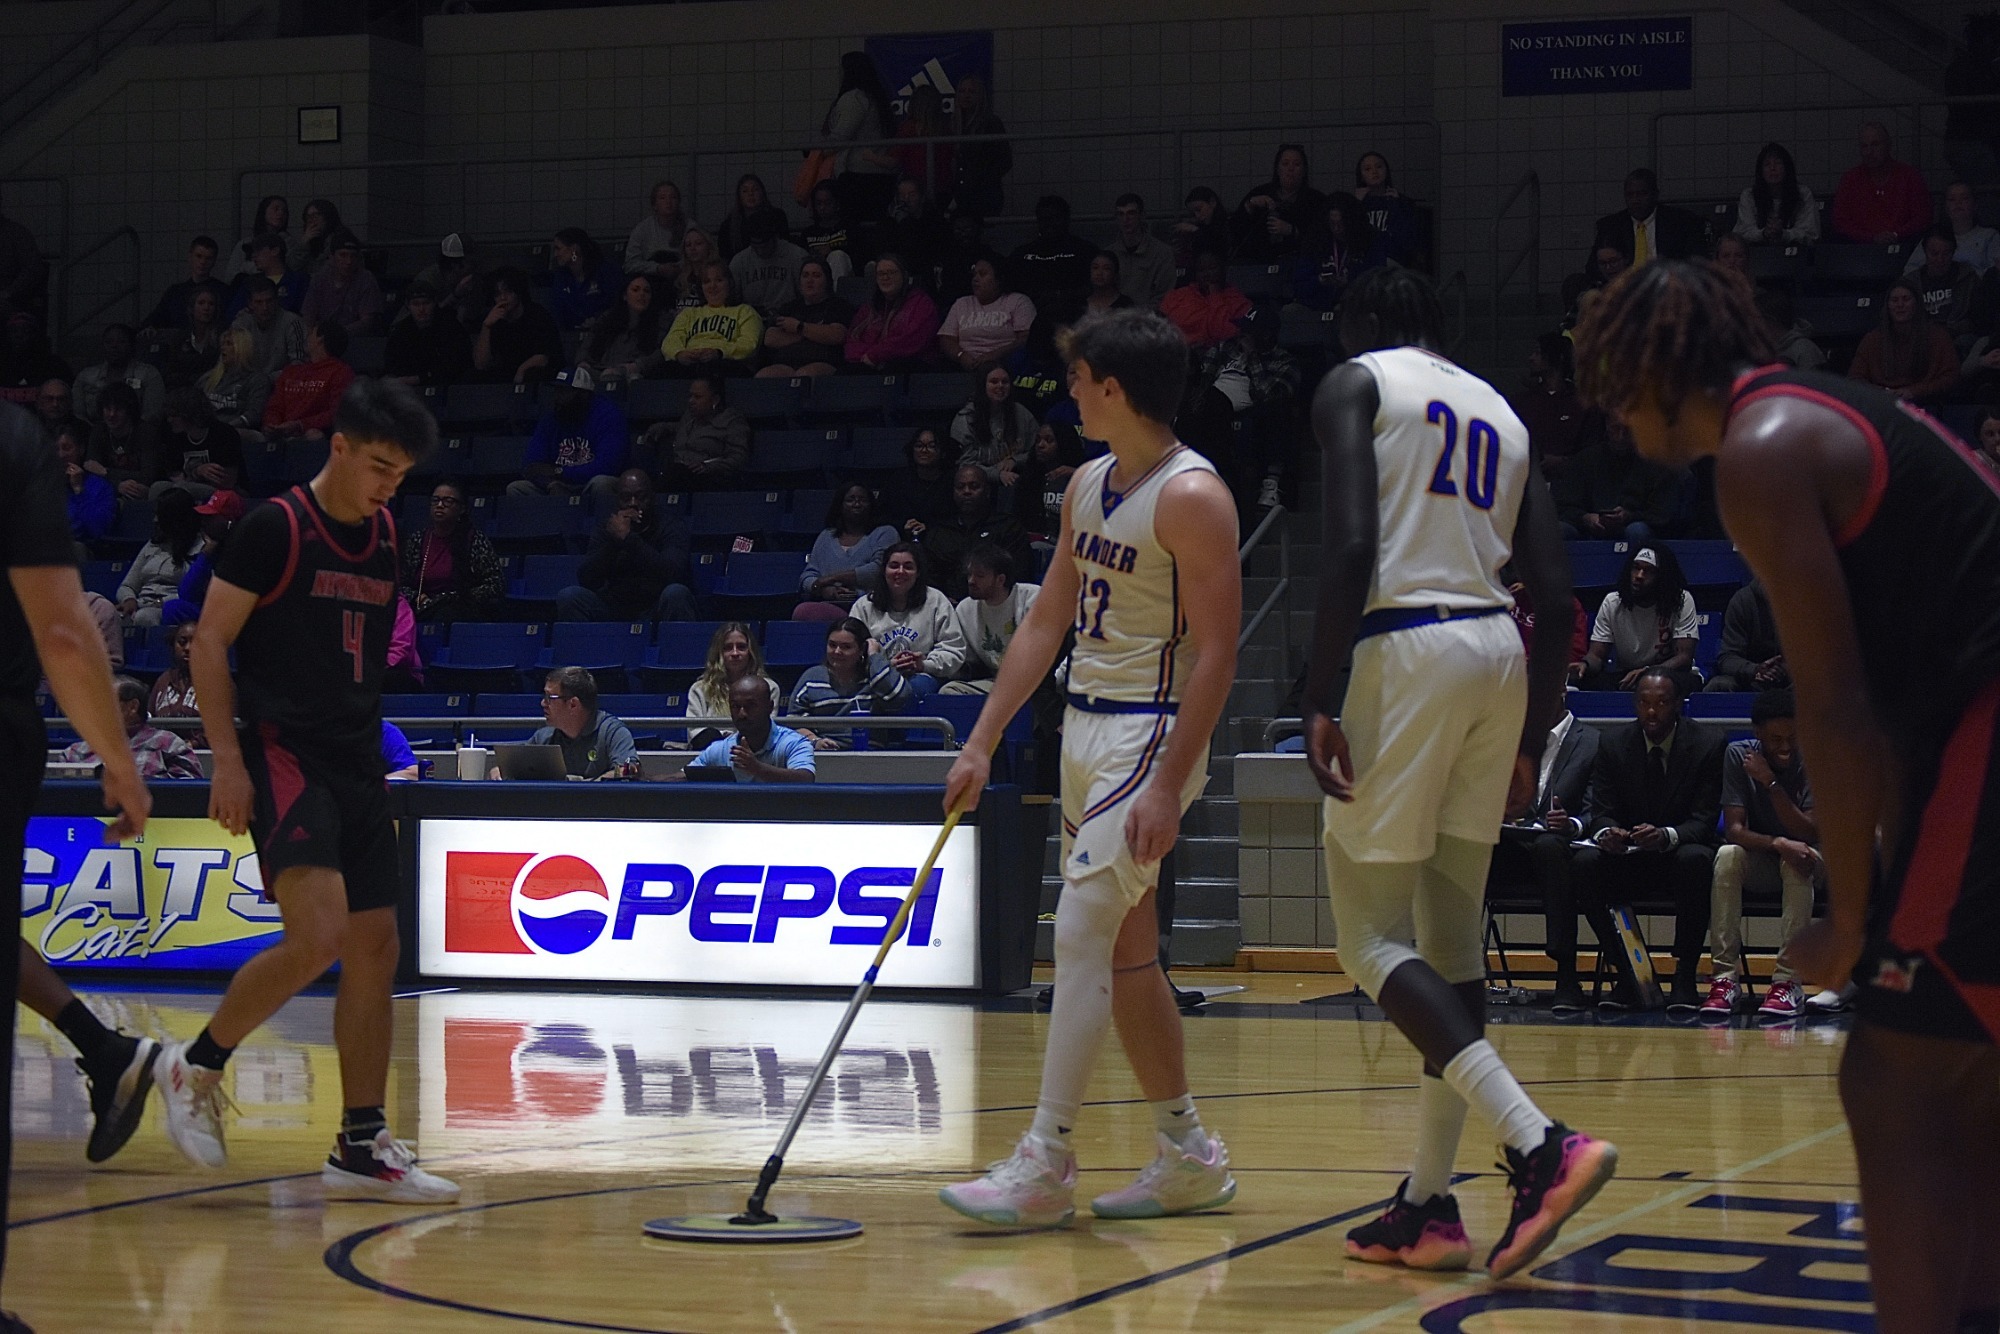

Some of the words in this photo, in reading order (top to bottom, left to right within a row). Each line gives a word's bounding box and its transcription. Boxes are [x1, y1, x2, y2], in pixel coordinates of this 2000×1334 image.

[1509, 37, 1532, 50] NO
[1535, 34, 1614, 49] STANDING
[1619, 32, 1636, 46] IN
[1640, 31, 1685, 45] AISLE
[1550, 65, 1605, 80] THANK
[1609, 64, 1643, 78] YOU
[745, 265, 787, 284] LANDER
[959, 311, 1008, 328] LANDER
[1427, 400, 1500, 510] 20
[1074, 531, 1137, 573] ANDER
[1077, 572, 1111, 641] 12
[343, 610, 366, 683] 4
[878, 627, 919, 647] LANDER
[612, 863, 943, 946] PEPSI
[39, 902, 179, 961] Cat!
